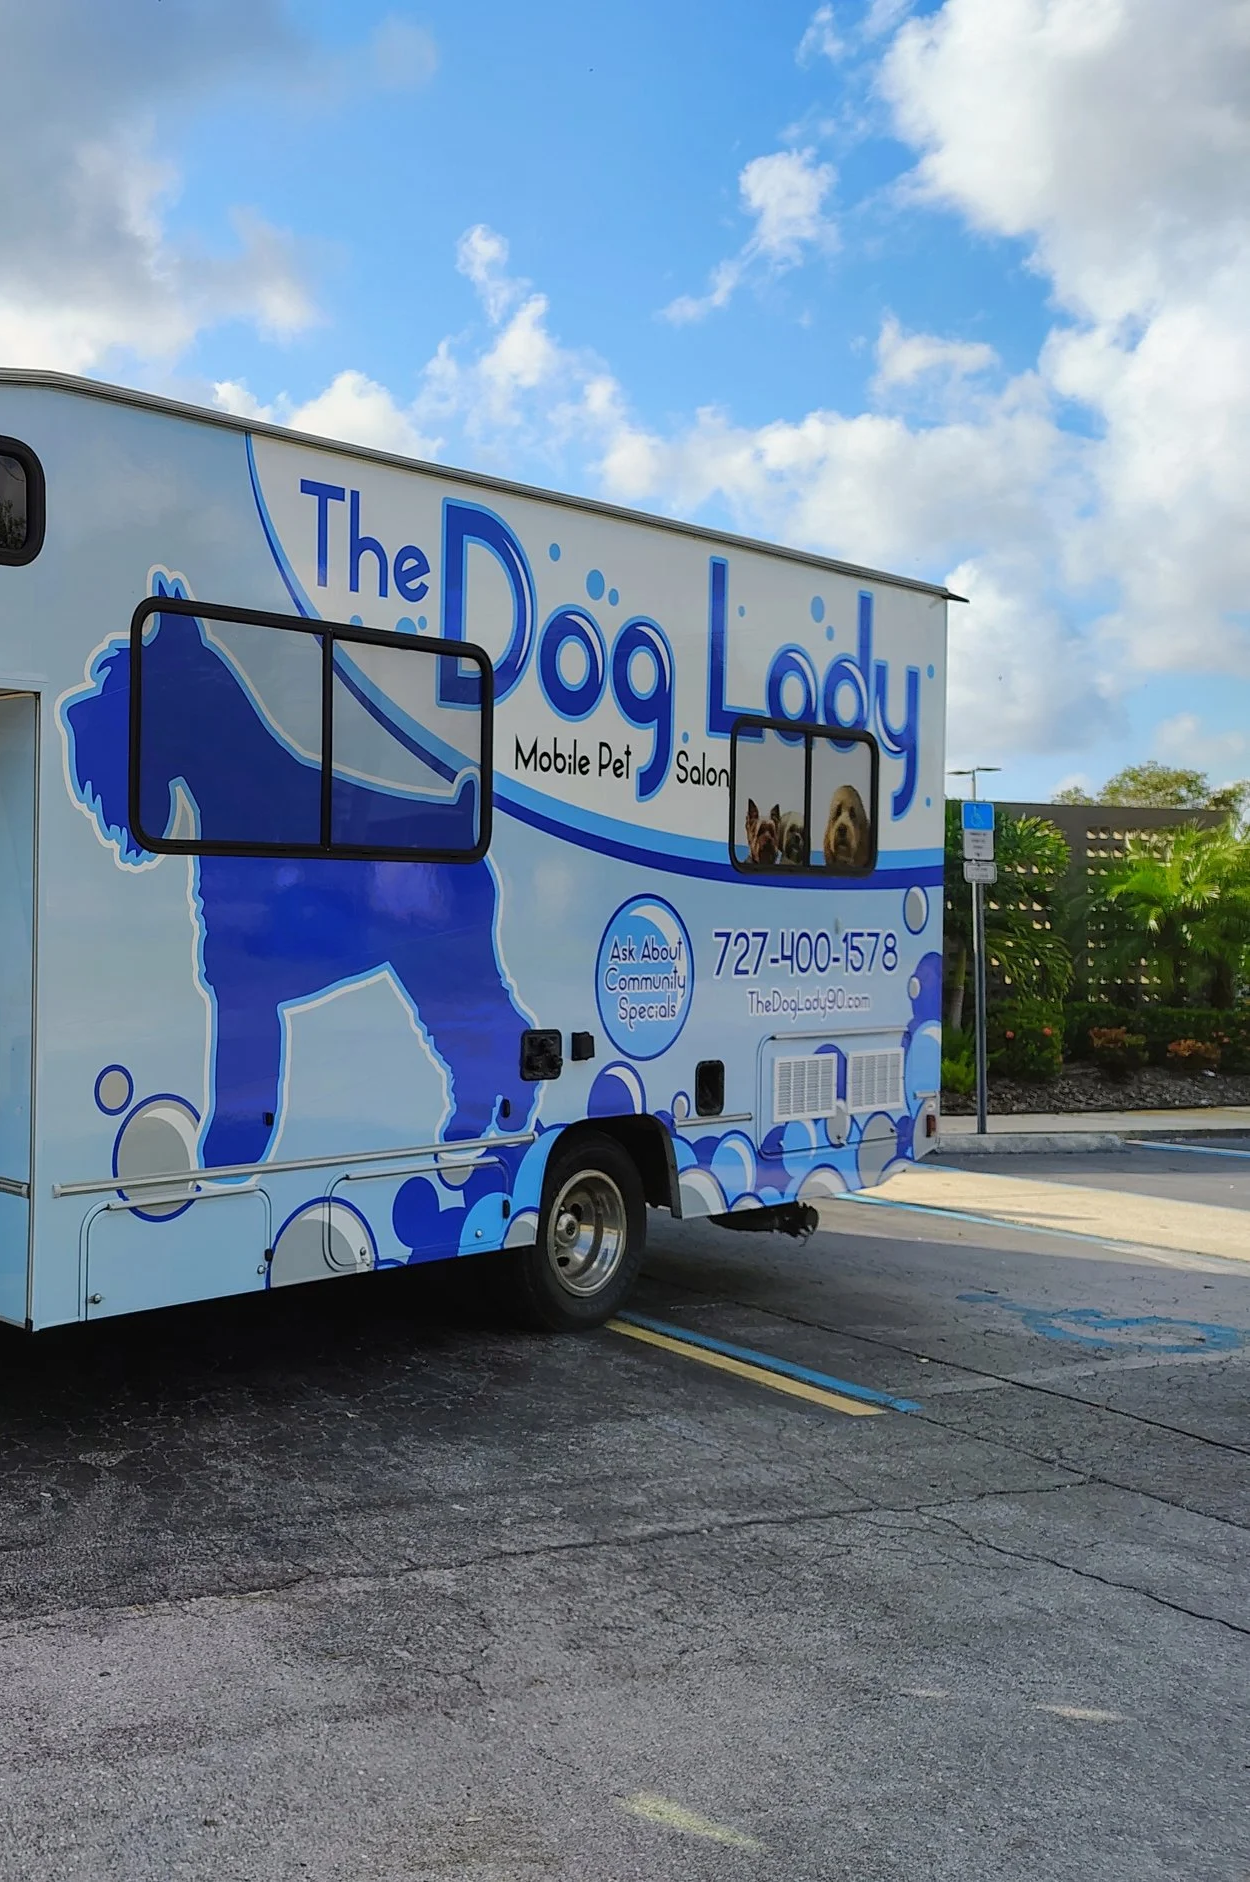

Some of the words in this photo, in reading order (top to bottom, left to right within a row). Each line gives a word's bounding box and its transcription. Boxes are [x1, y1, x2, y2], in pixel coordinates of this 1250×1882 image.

[299, 478, 432, 603] The
[436, 496, 676, 803] Dog
[705, 555, 921, 822] Lady
[514, 733, 591, 776] Mobile
[598, 741, 632, 780] Pet
[675, 749, 730, 788] Salon
[610, 936, 636, 962] Ask
[640, 936, 683, 962] About
[713, 930, 899, 977] 727-400-1578
[604, 965, 687, 999] Community
[618, 994, 677, 1030] Specials
[748, 987, 872, 1021] TheDogLady90.com
